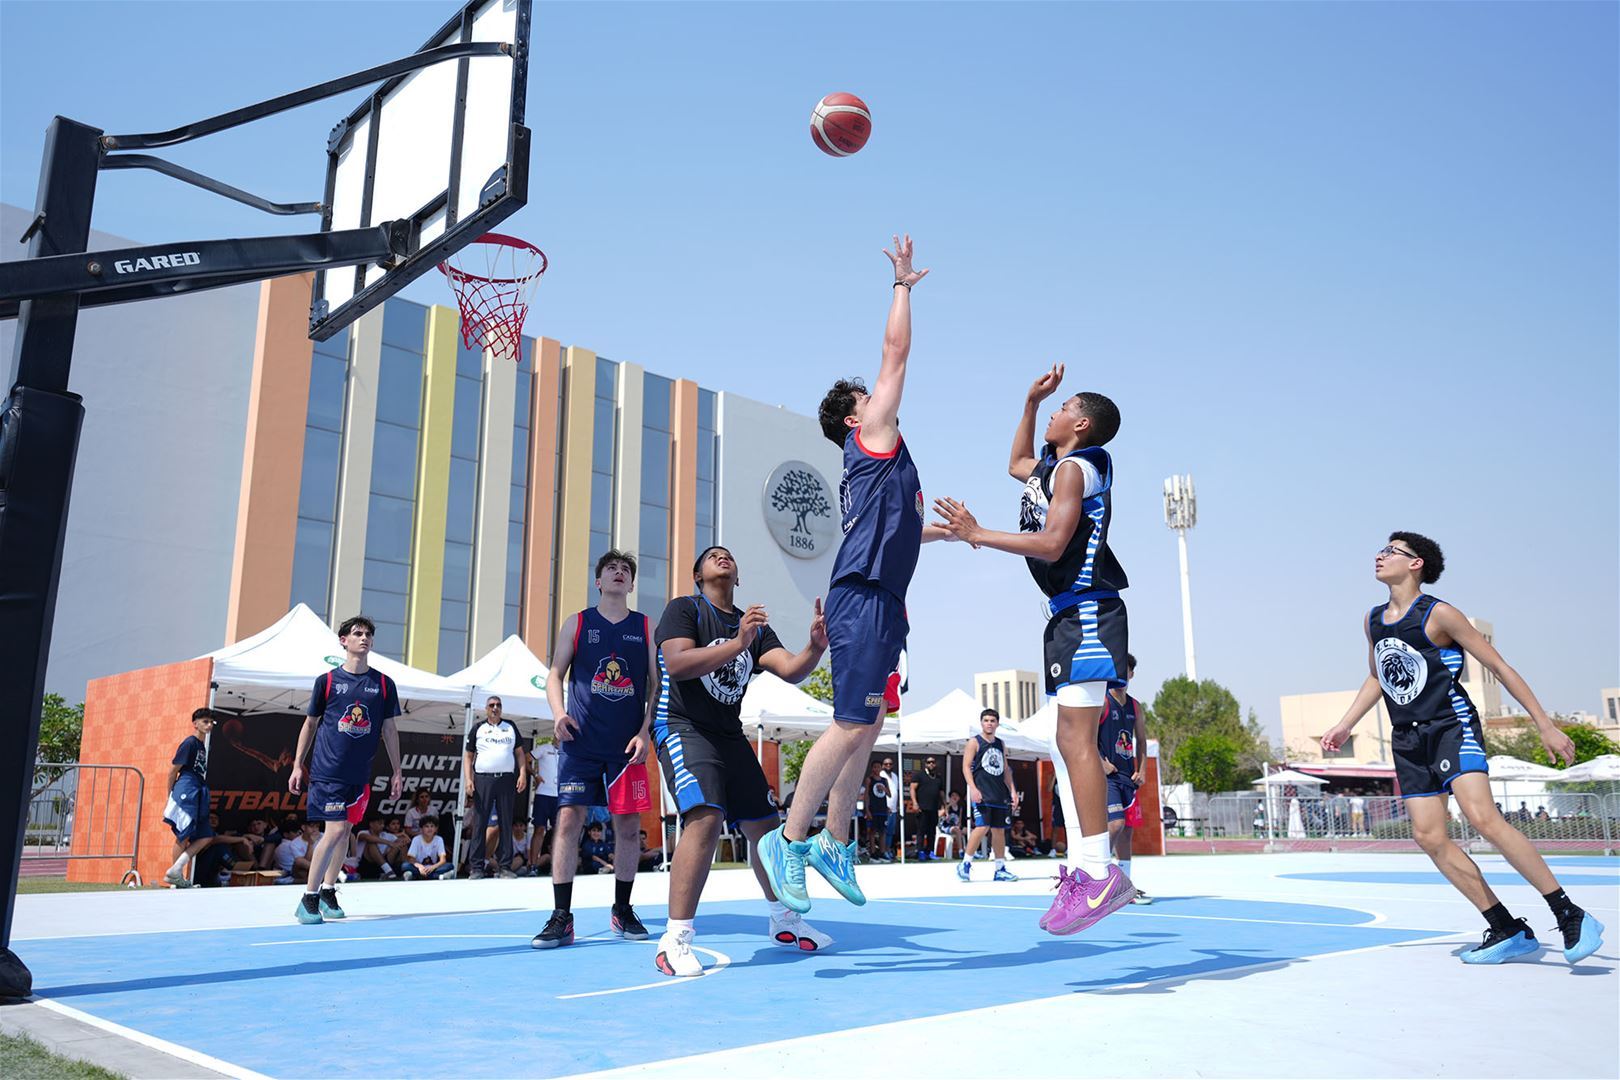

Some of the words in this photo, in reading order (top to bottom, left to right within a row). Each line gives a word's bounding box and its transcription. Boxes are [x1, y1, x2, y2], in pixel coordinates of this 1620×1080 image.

[114, 252, 200, 274] GARED
[789, 535, 815, 551] 1886
[587, 629, 600, 644] 15
[335, 683, 349, 695] 99
[631, 780, 647, 800] 15
